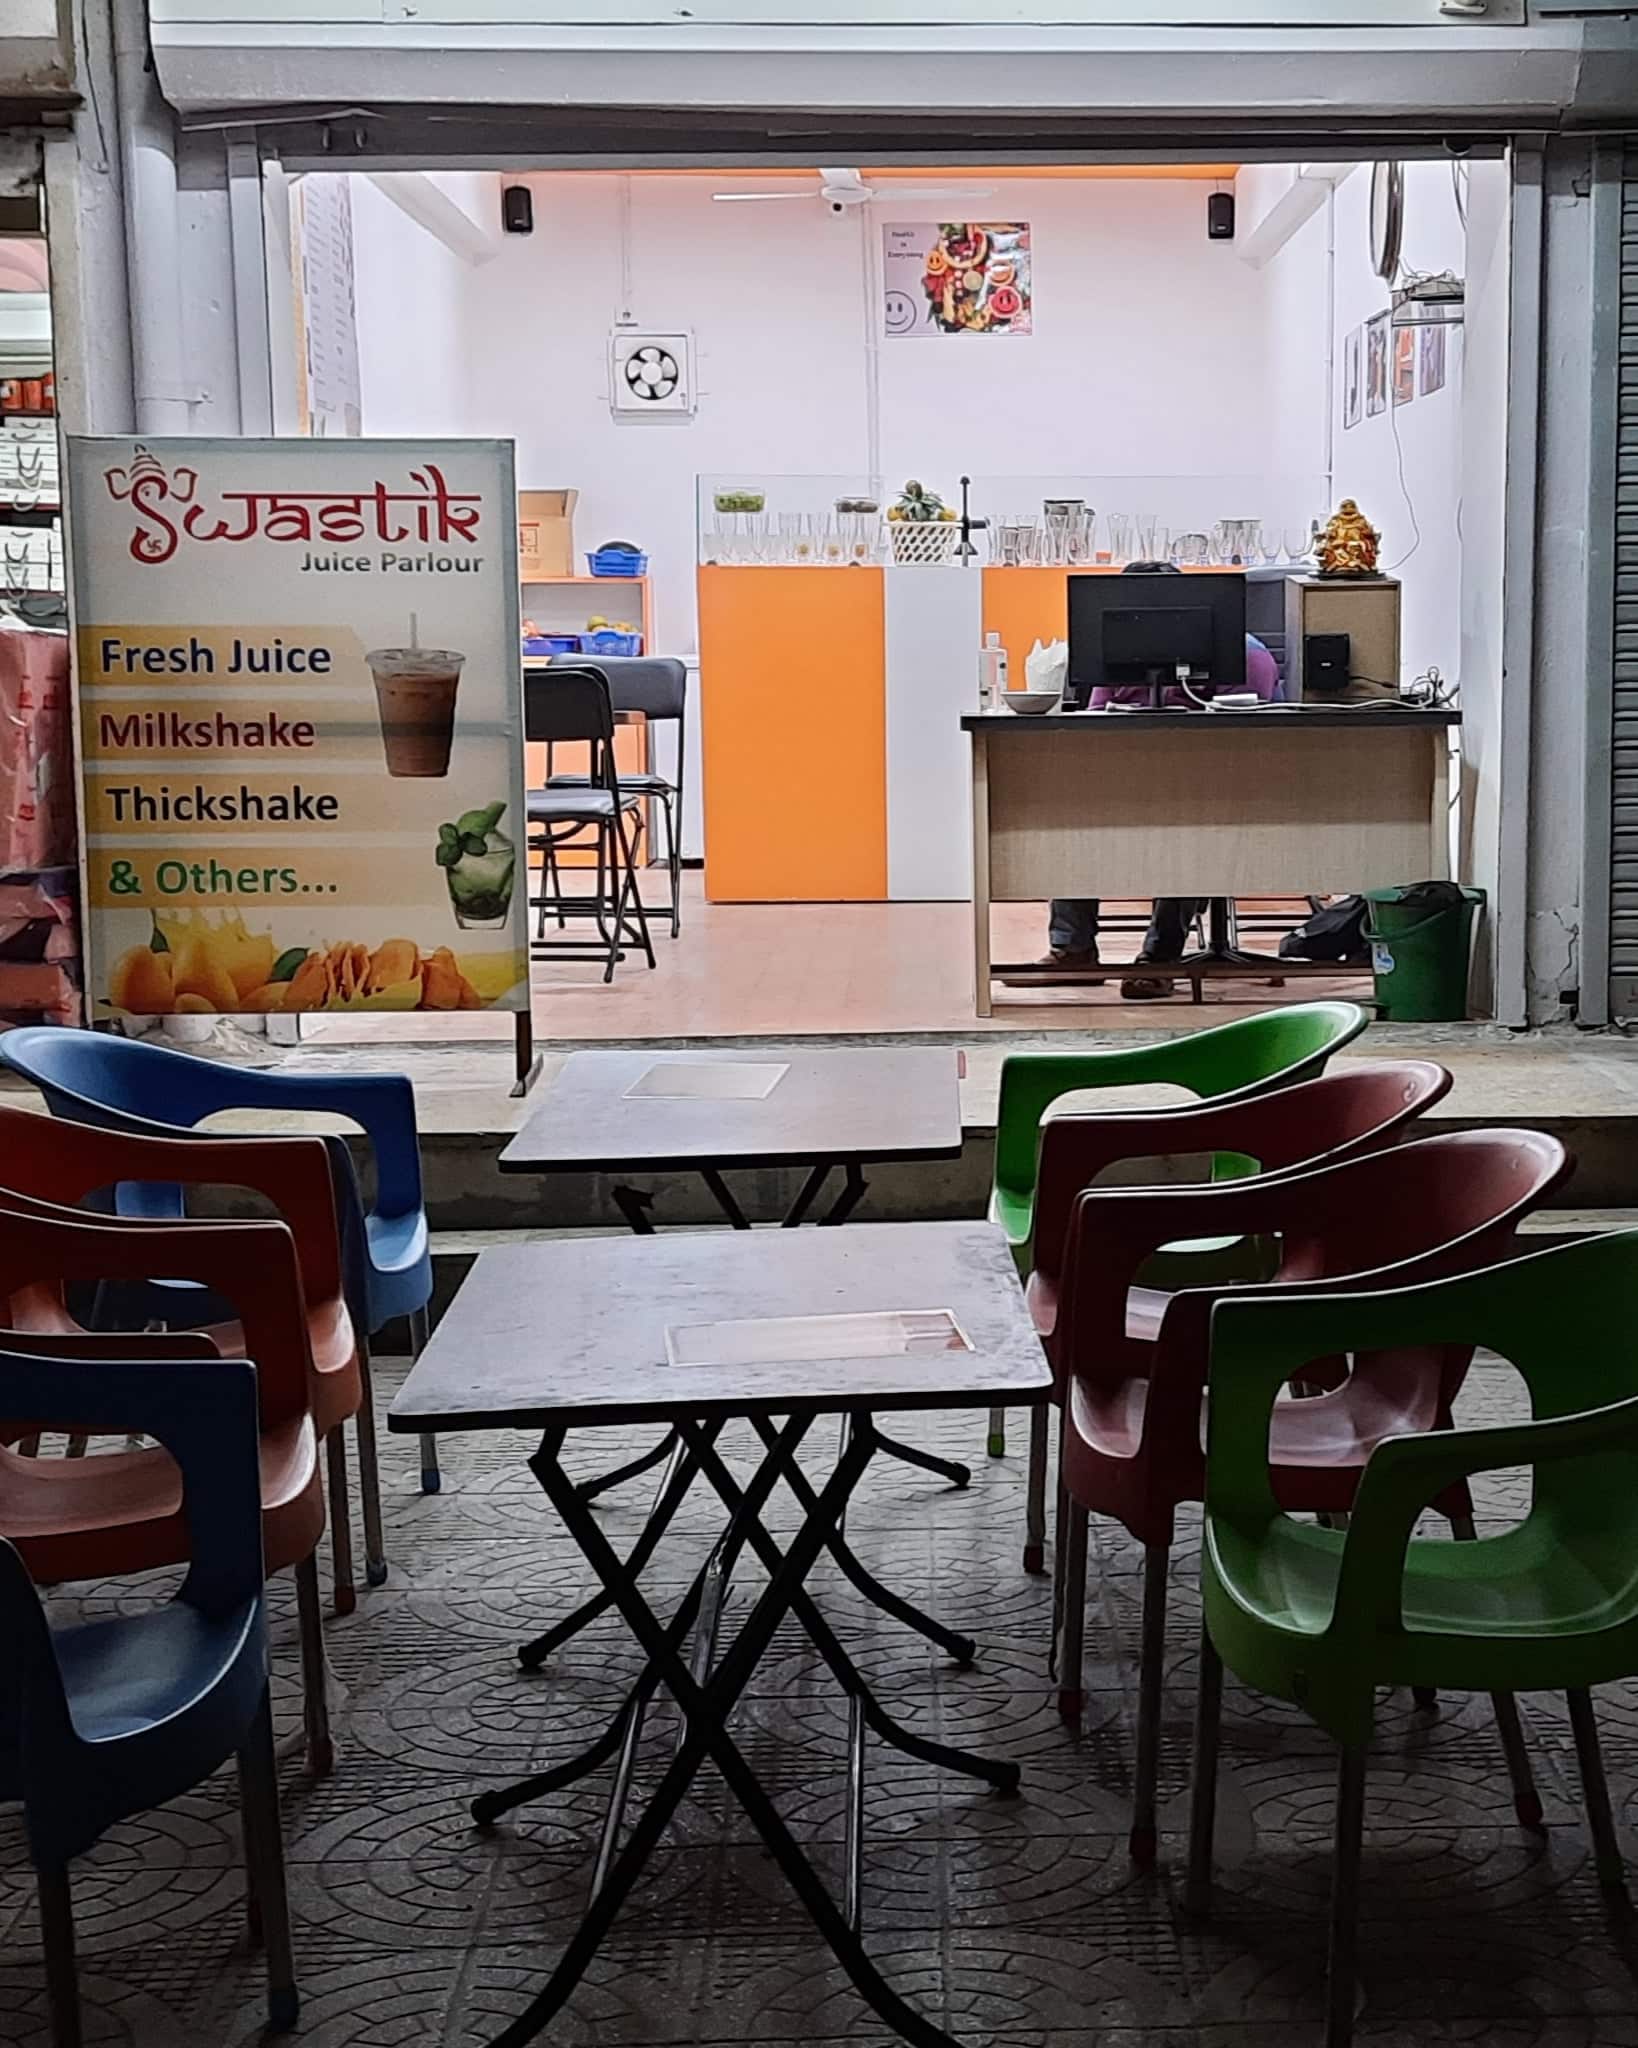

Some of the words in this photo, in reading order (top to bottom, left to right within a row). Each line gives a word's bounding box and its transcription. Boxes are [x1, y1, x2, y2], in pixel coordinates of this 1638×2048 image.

[129, 464, 482, 564] Swastik
[300, 552, 371, 572] Juice
[381, 552, 484, 573] Parlour
[100, 638, 214, 674] Fresh
[227, 638, 331, 674] Juice
[100, 712, 316, 748] Milkshake
[106, 784, 339, 821] Thickshake
[107, 860, 142, 895] &
[155, 858, 338, 895] Others...
